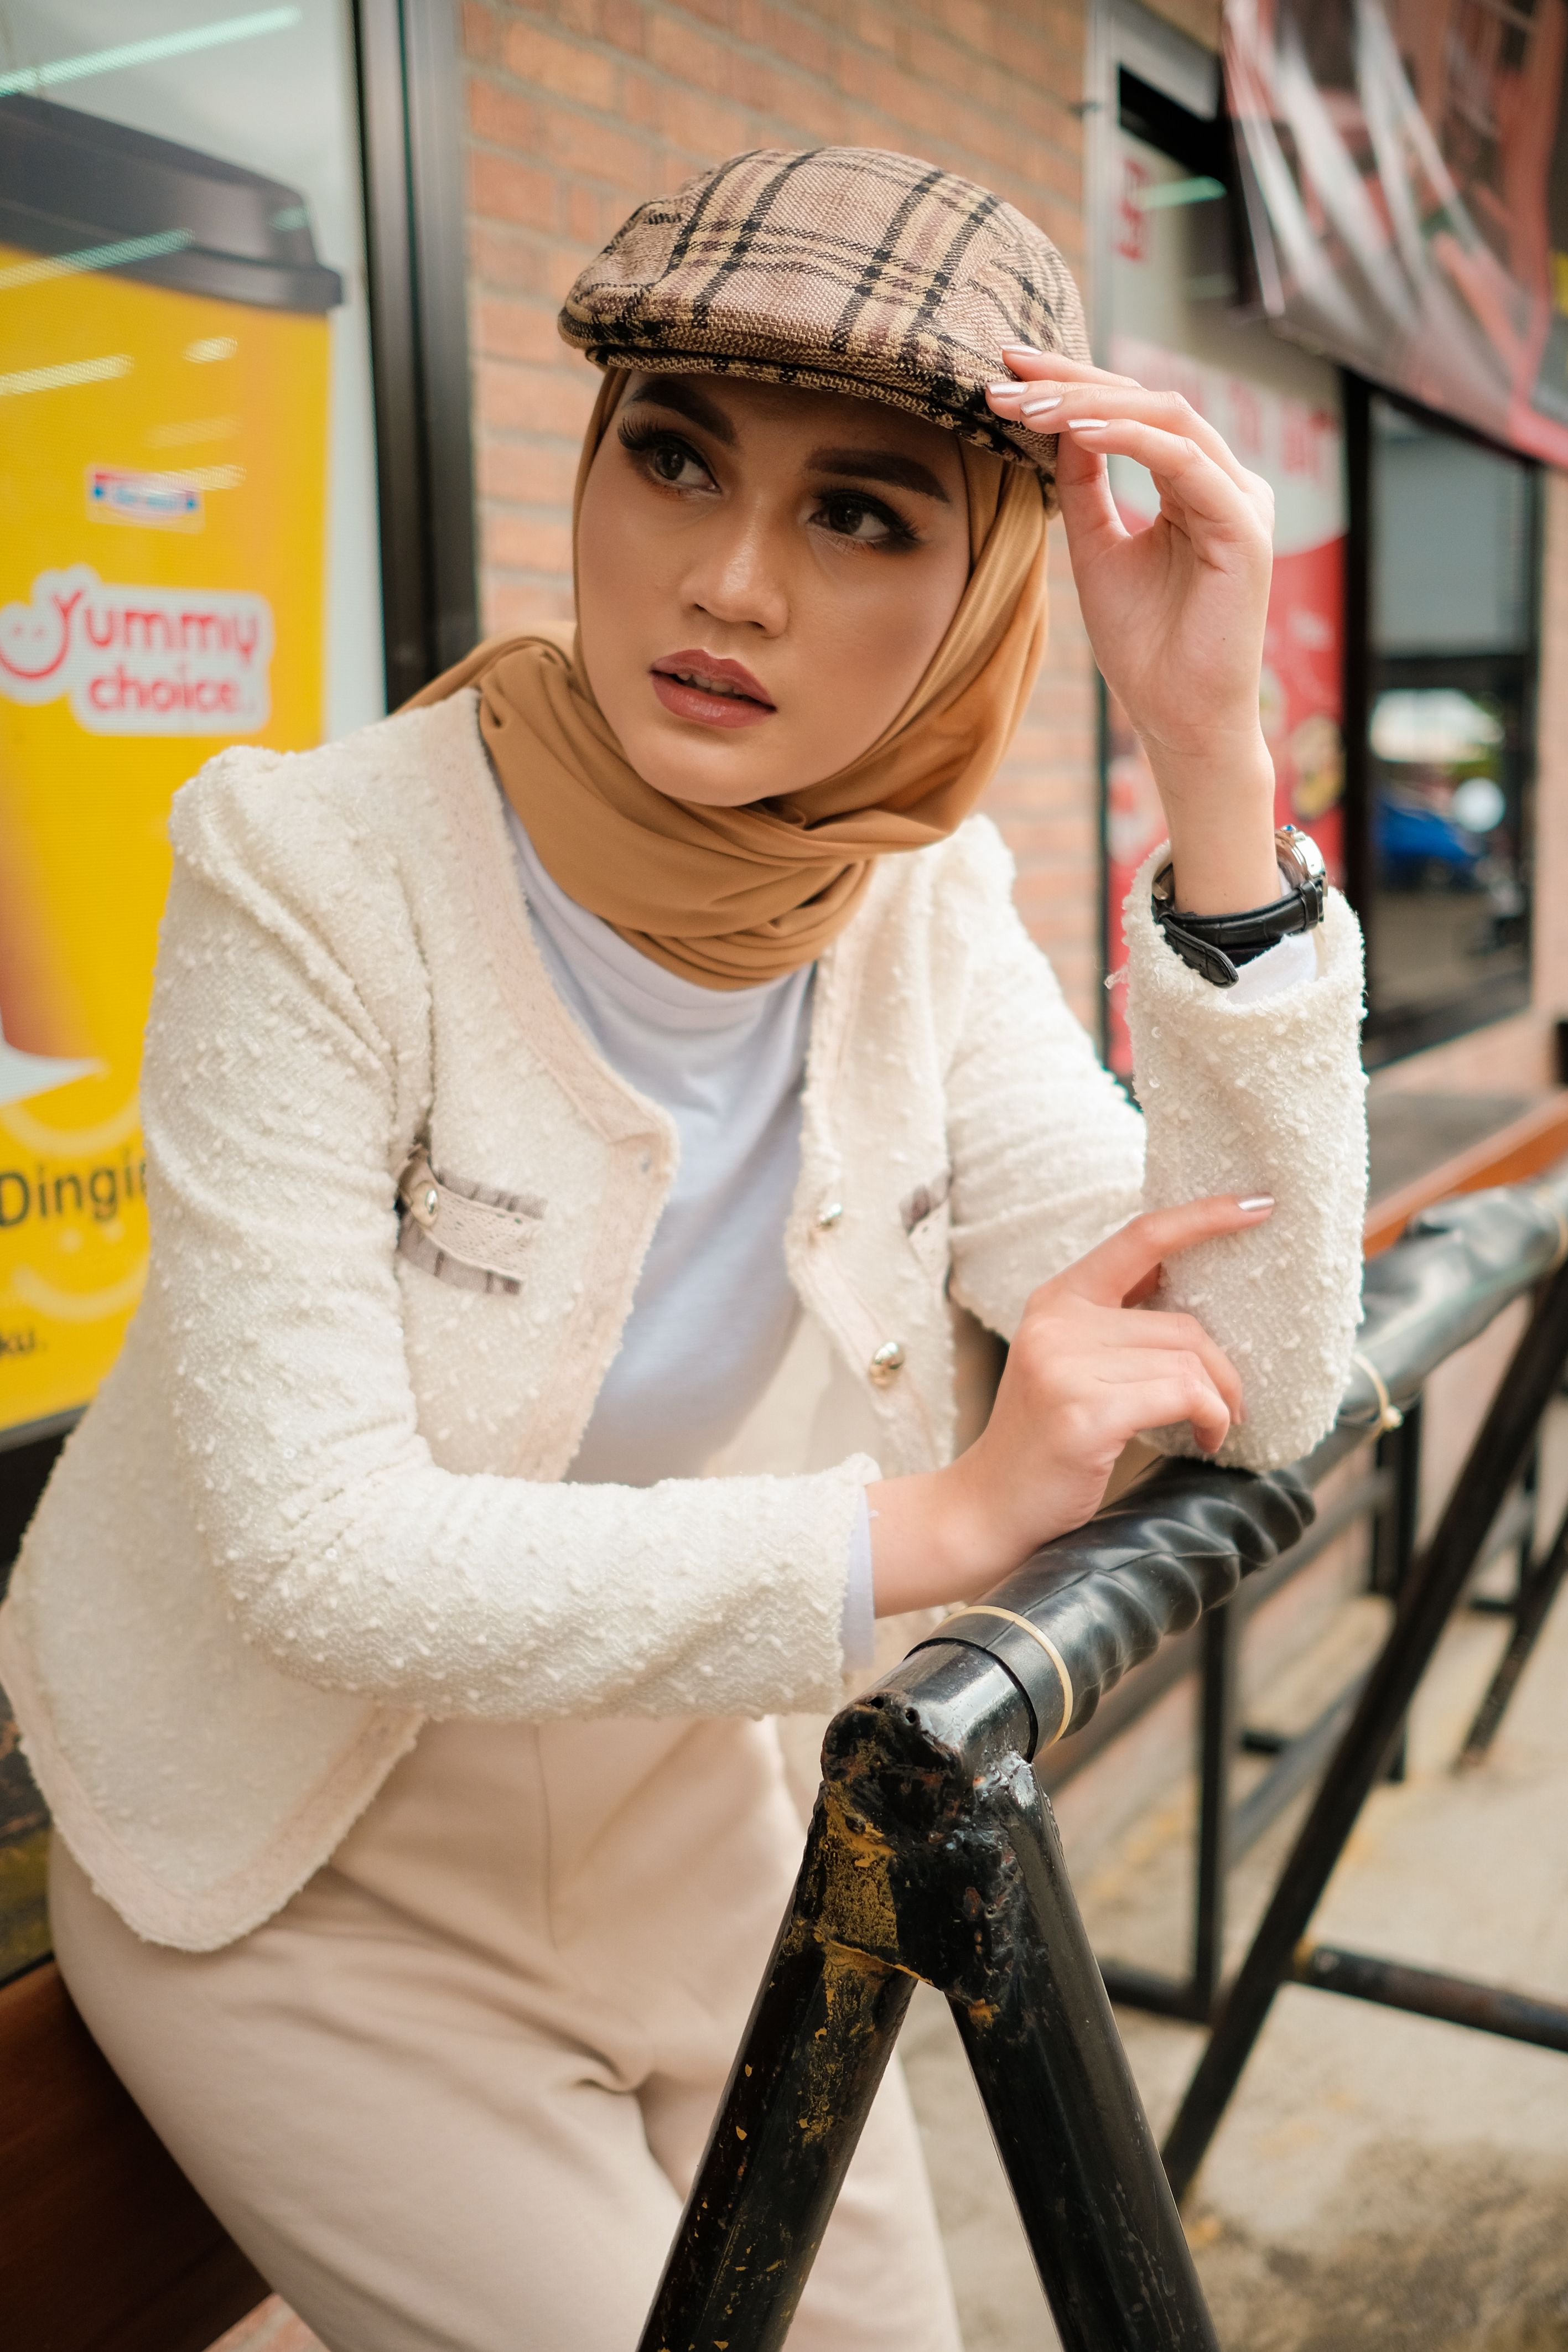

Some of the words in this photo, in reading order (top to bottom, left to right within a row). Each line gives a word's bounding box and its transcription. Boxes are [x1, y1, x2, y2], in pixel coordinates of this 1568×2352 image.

[0, 589, 260, 681] Yummy
[87, 662, 241, 714] choice
[0, 1146, 146, 1227] Dingi
